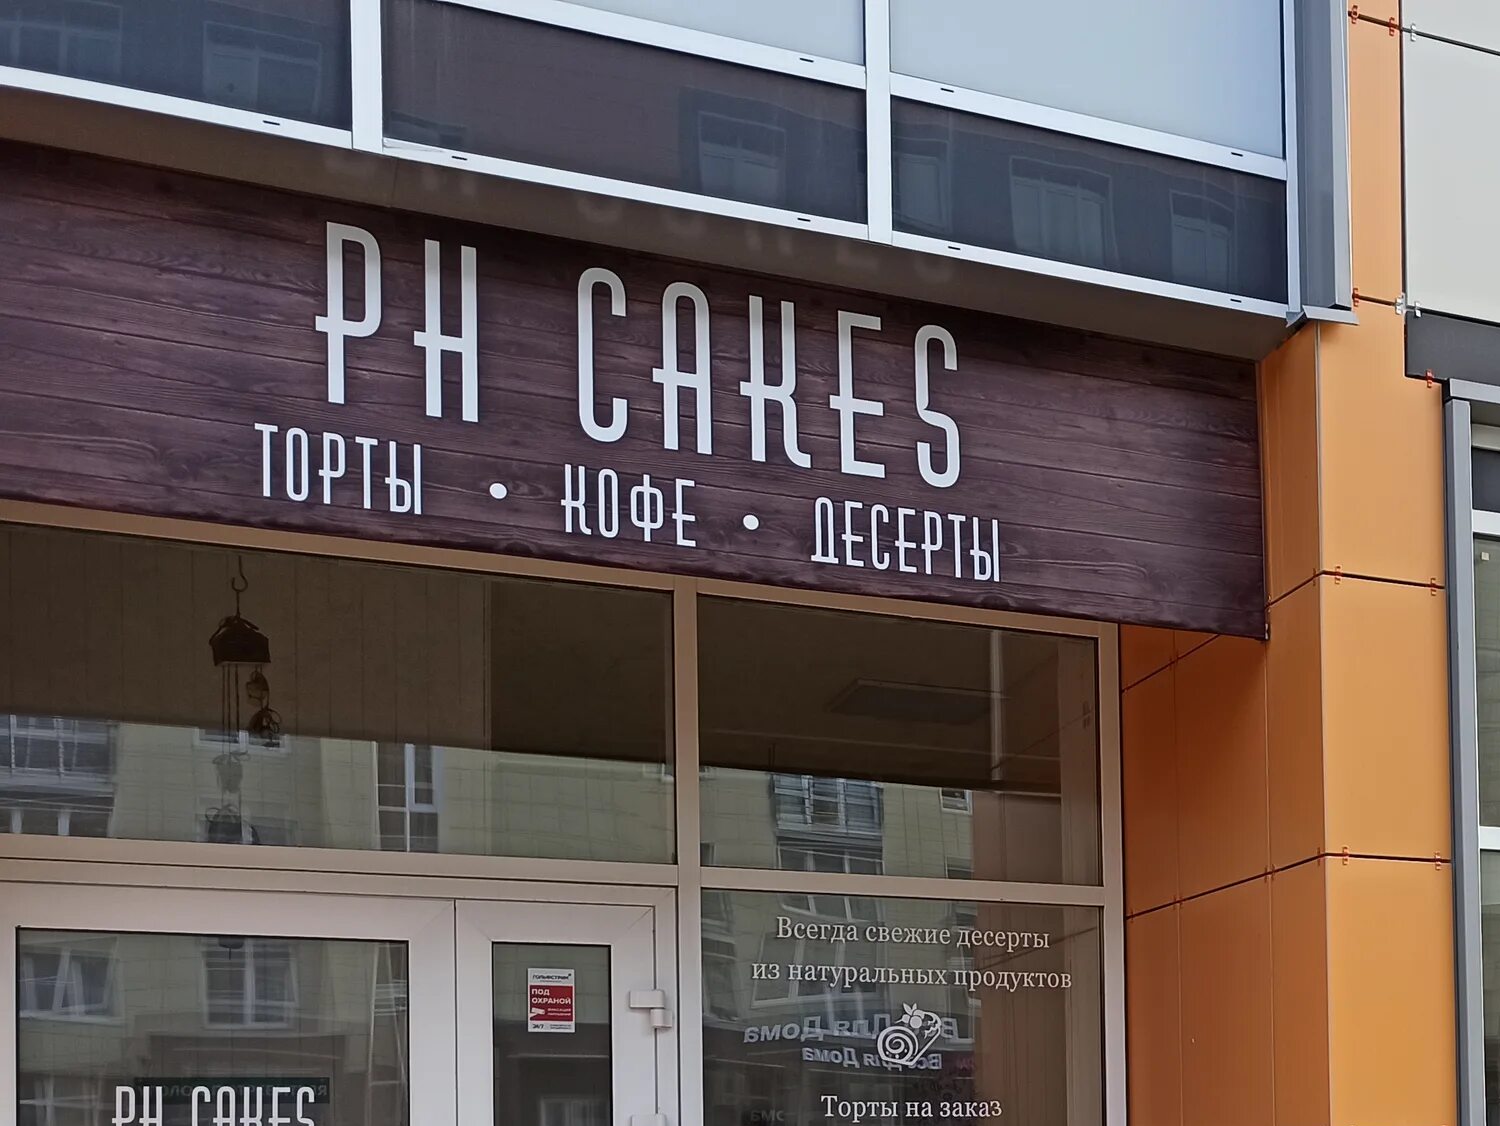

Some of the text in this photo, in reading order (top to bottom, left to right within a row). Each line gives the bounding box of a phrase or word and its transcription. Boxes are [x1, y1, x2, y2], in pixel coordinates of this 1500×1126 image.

[315, 222, 961, 488] PH CAKES
[254, 423, 1001, 582] ТОРТЫ КОФЕ ДЕСЕРТЫ
[776, 916, 1050, 952] Всегда свежие десерты
[751, 961, 1072, 991] из натуральных продуктов
[531, 988, 550, 996] ПОД
[531, 997, 571, 1005] ОХРАНОЙ
[821, 1095, 1002, 1122] Торты на заказ
